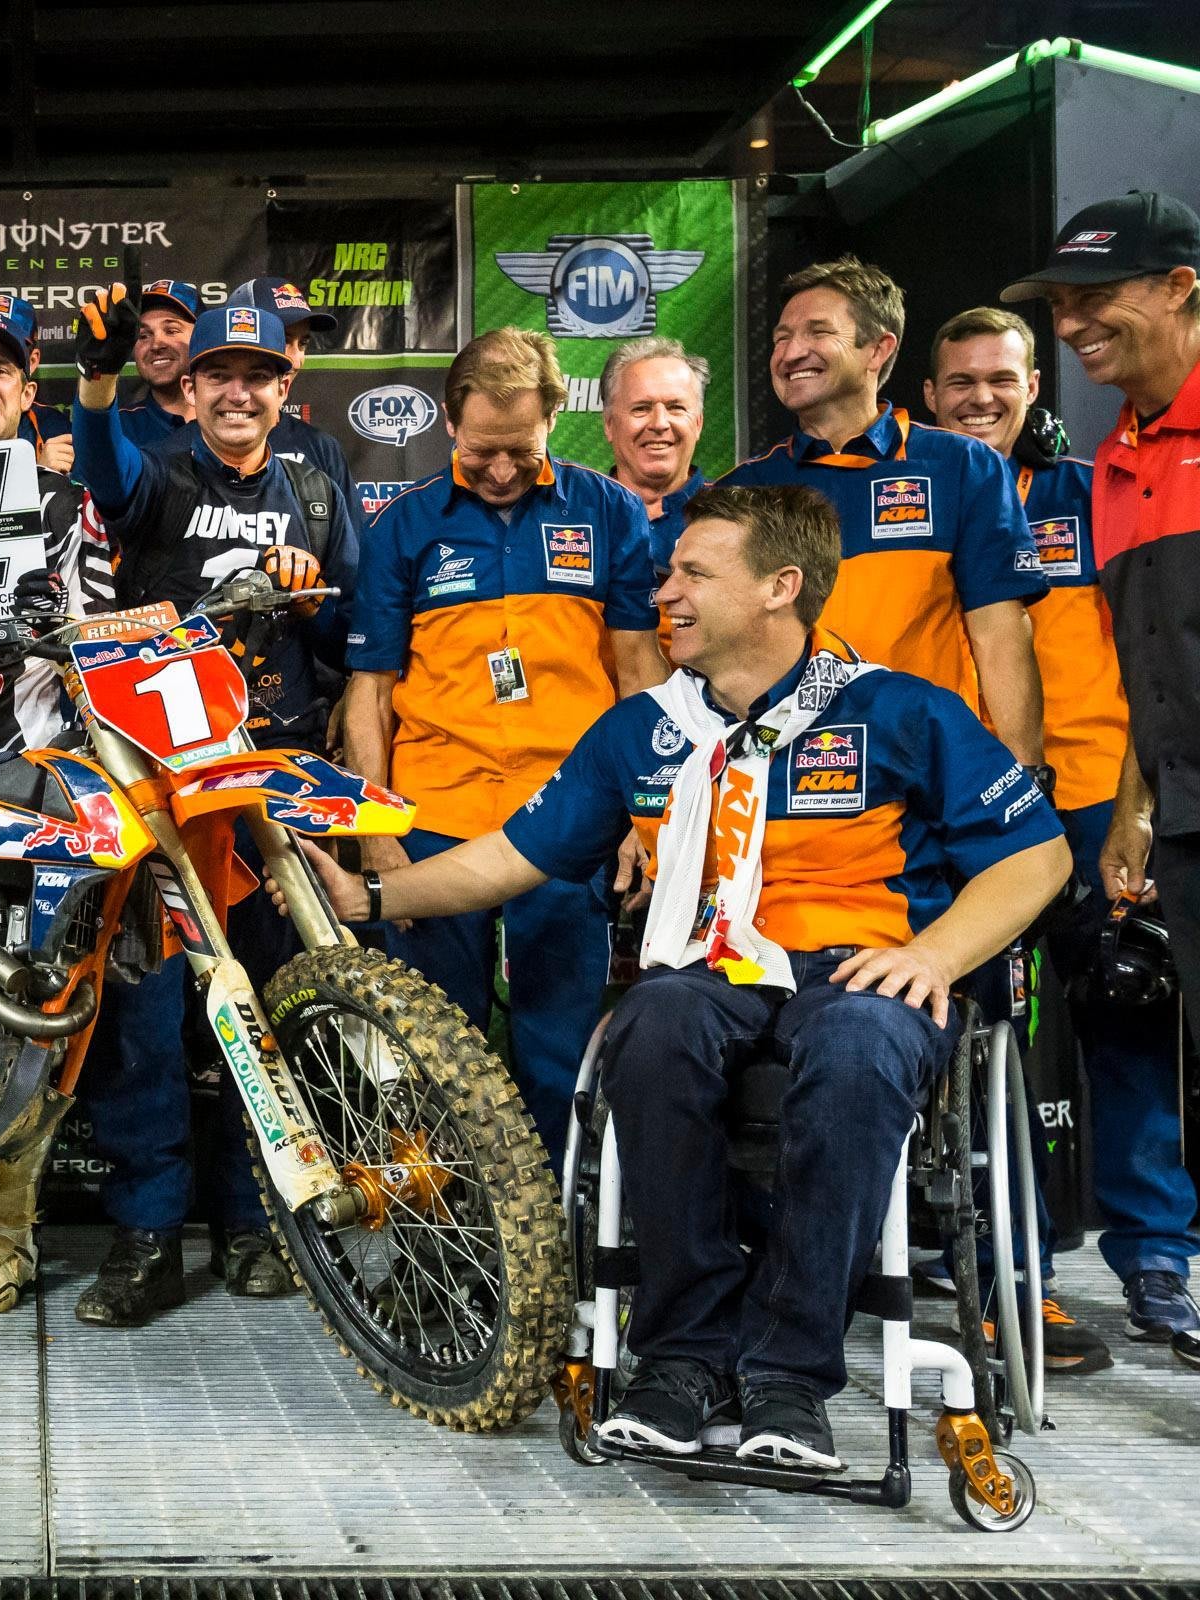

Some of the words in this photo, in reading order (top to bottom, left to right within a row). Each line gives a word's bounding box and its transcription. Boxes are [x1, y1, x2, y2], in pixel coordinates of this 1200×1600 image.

[6, 257, 119, 270] ENERG
[334, 243, 388, 270] NRG
[308, 279, 413, 306] STADIUM
[568, 266, 634, 307] FIM
[369, 396, 416, 418] FOX
[368, 418, 418, 427] SPORTS
[396, 428, 407, 445] 1
[878, 494, 902, 505] Red
[902, 493, 925, 504] Bull
[878, 506, 927, 523] KTM
[550, 542, 570, 552] Red
[570, 541, 590, 553] Bull
[552, 554, 590, 569] KTM
[87, 613, 172, 641] RENTHAL
[79, 656, 103, 668] Red
[102, 648, 126, 661] Bull
[133, 658, 212, 749] 1
[183, 744, 230, 763] MOTOREX
[796, 753, 826, 770] Red
[826, 749, 857, 768] Bull
[795, 770, 858, 792] KTM
[980, 765, 1018, 802] SCORPION
[794, 798, 830, 807] FACTORY
[831, 795, 859, 805] RACING
[716, 766, 755, 880] KTM
[36, 872, 73, 889] KTM
[271, 987, 317, 1025] DUNLOP
[228, 1042, 282, 1140] MOTOREX
[390, 1168, 404, 1183] 5
